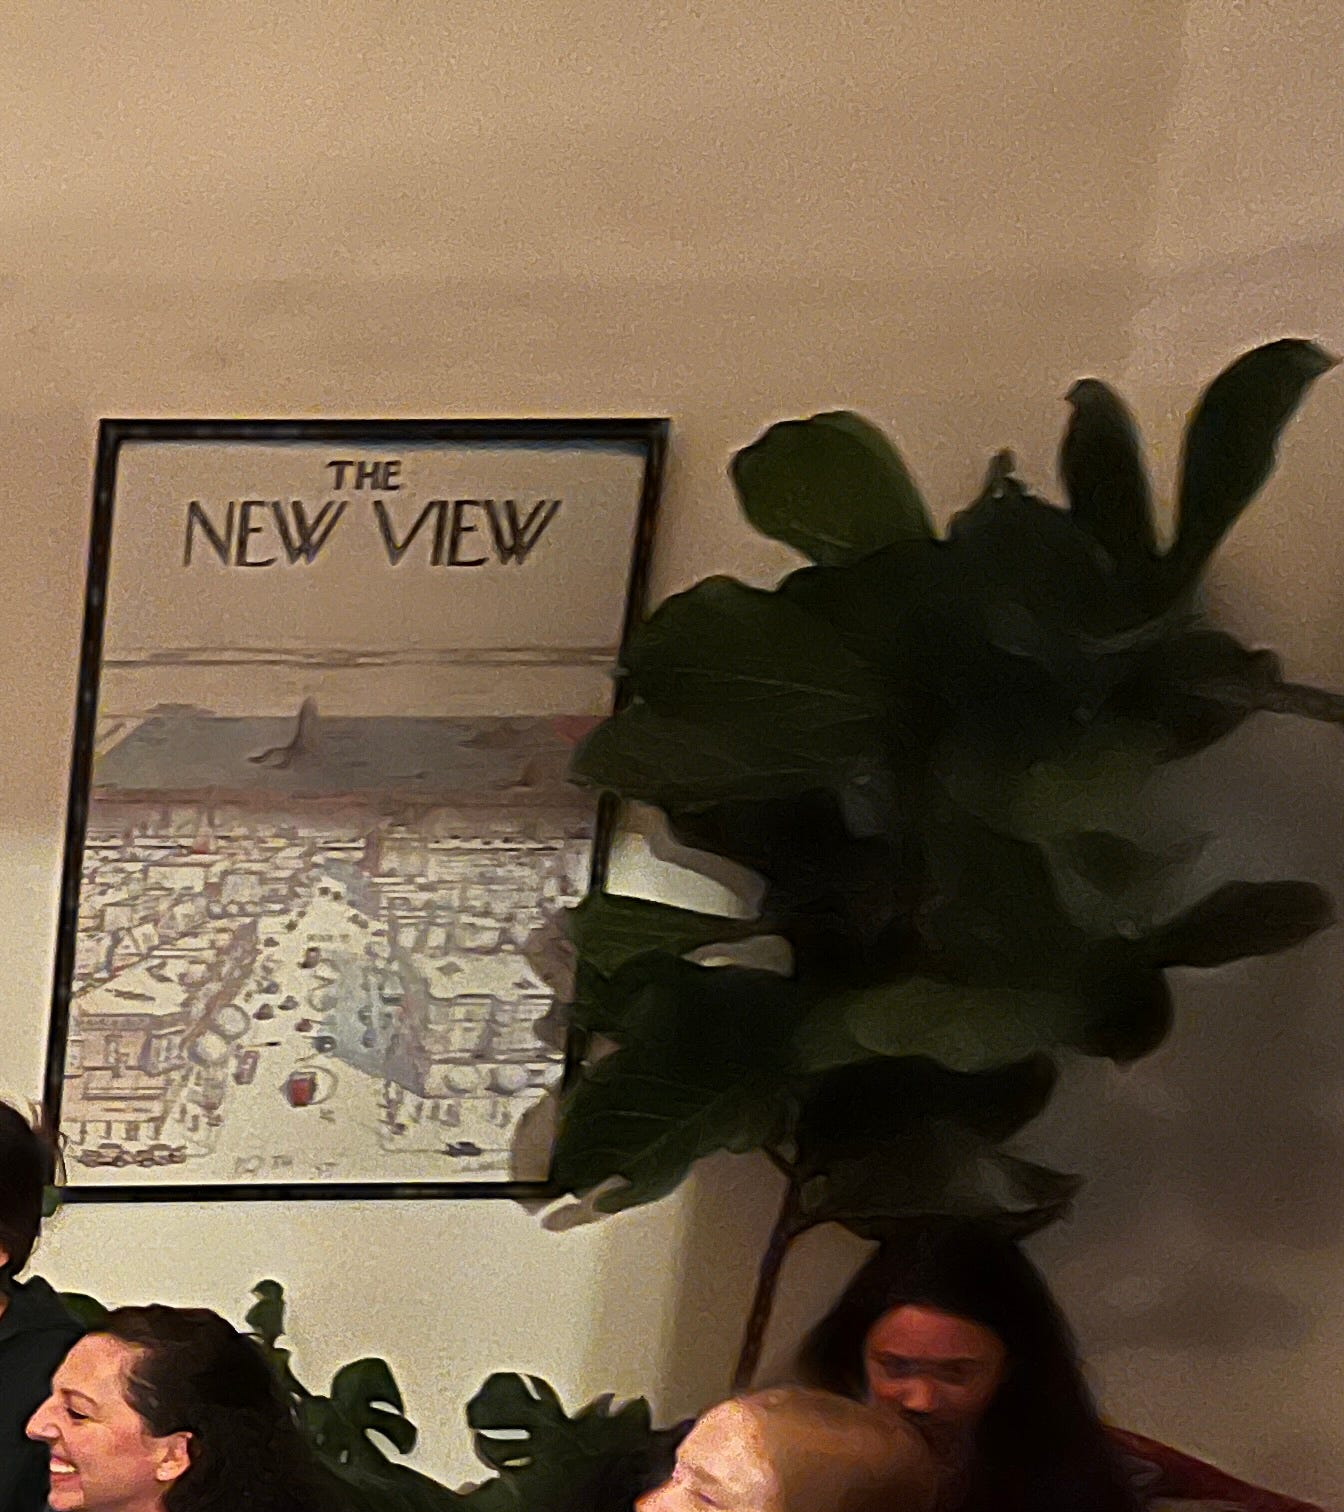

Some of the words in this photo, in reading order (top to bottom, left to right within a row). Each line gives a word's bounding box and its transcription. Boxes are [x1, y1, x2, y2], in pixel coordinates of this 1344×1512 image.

[326, 459, 402, 491] THE
[183, 500, 348, 567] NEW
[373, 500, 562, 567] VIEW
